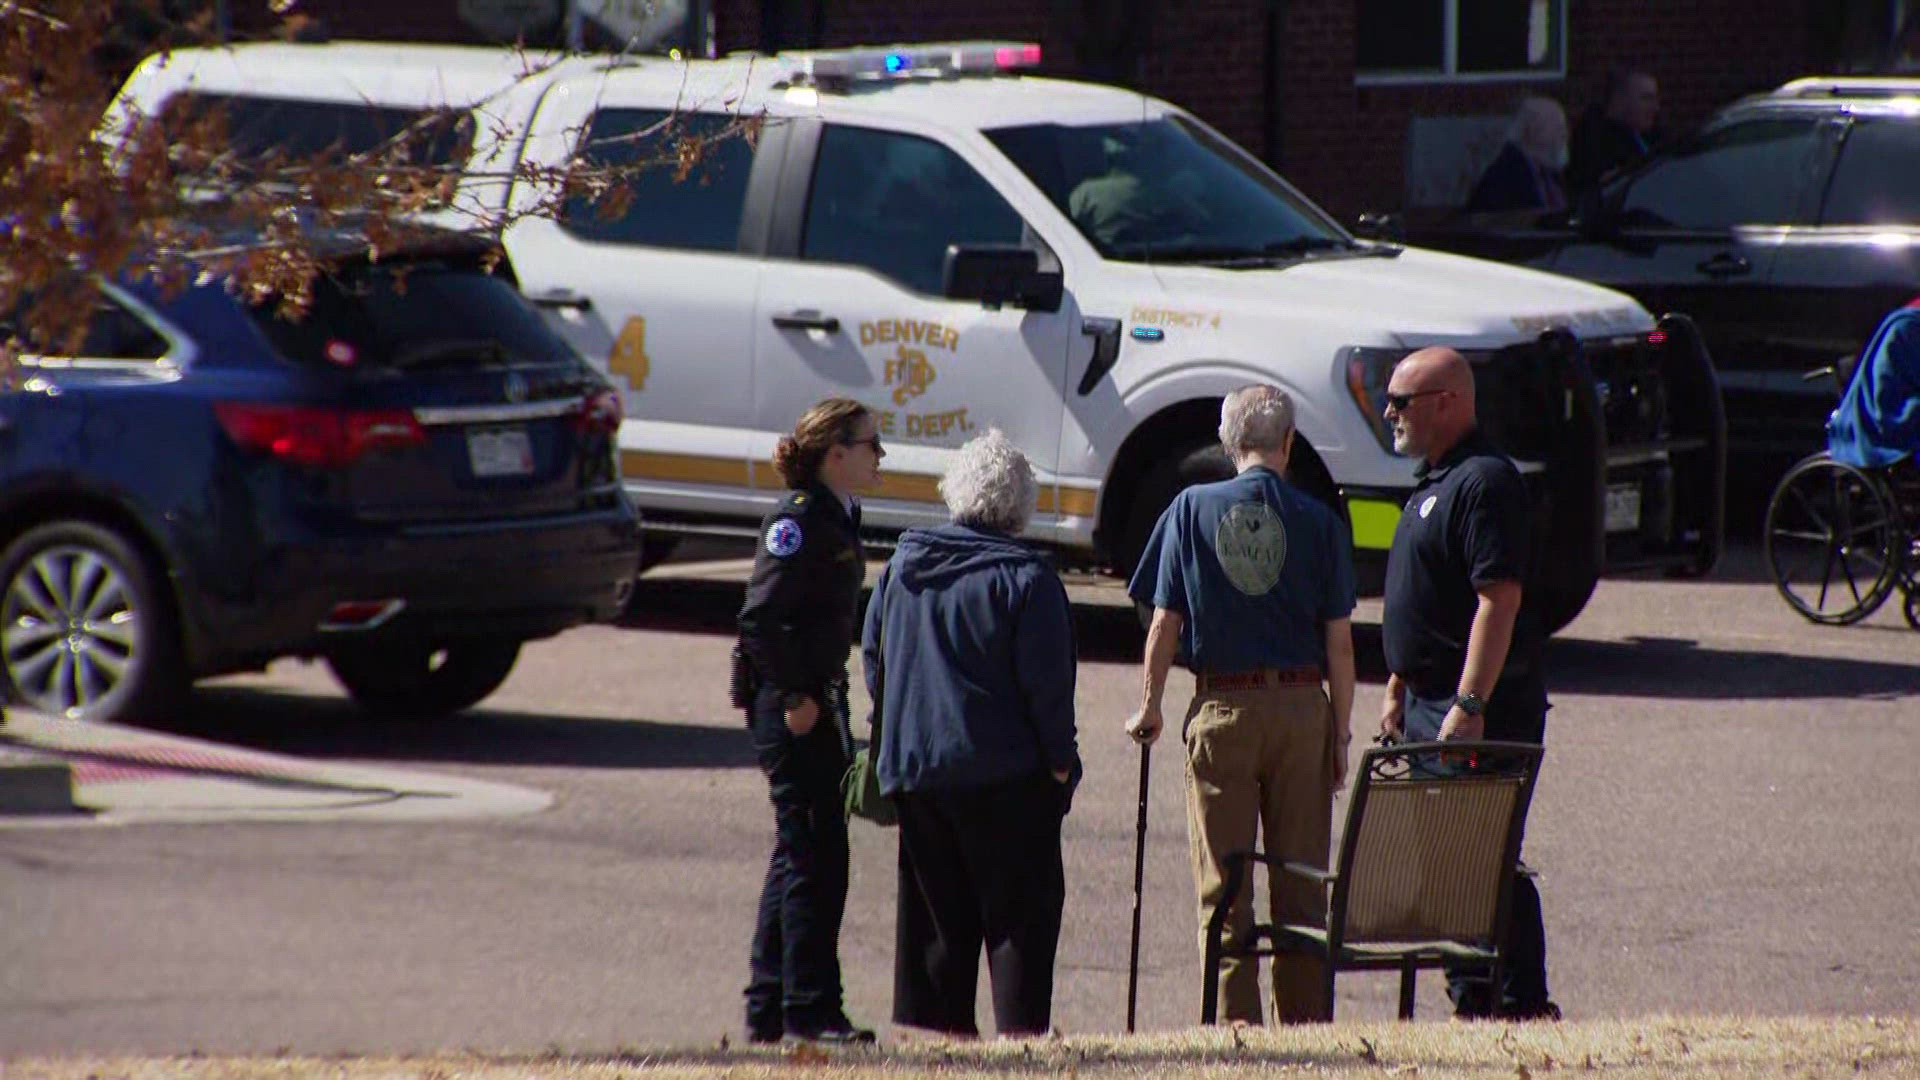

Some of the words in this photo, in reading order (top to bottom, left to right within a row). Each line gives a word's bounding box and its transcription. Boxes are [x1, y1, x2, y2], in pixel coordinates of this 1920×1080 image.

[608, 315, 650, 391] 4
[859, 318, 960, 353] DENVER
[906, 408, 976, 438] DEPT.
